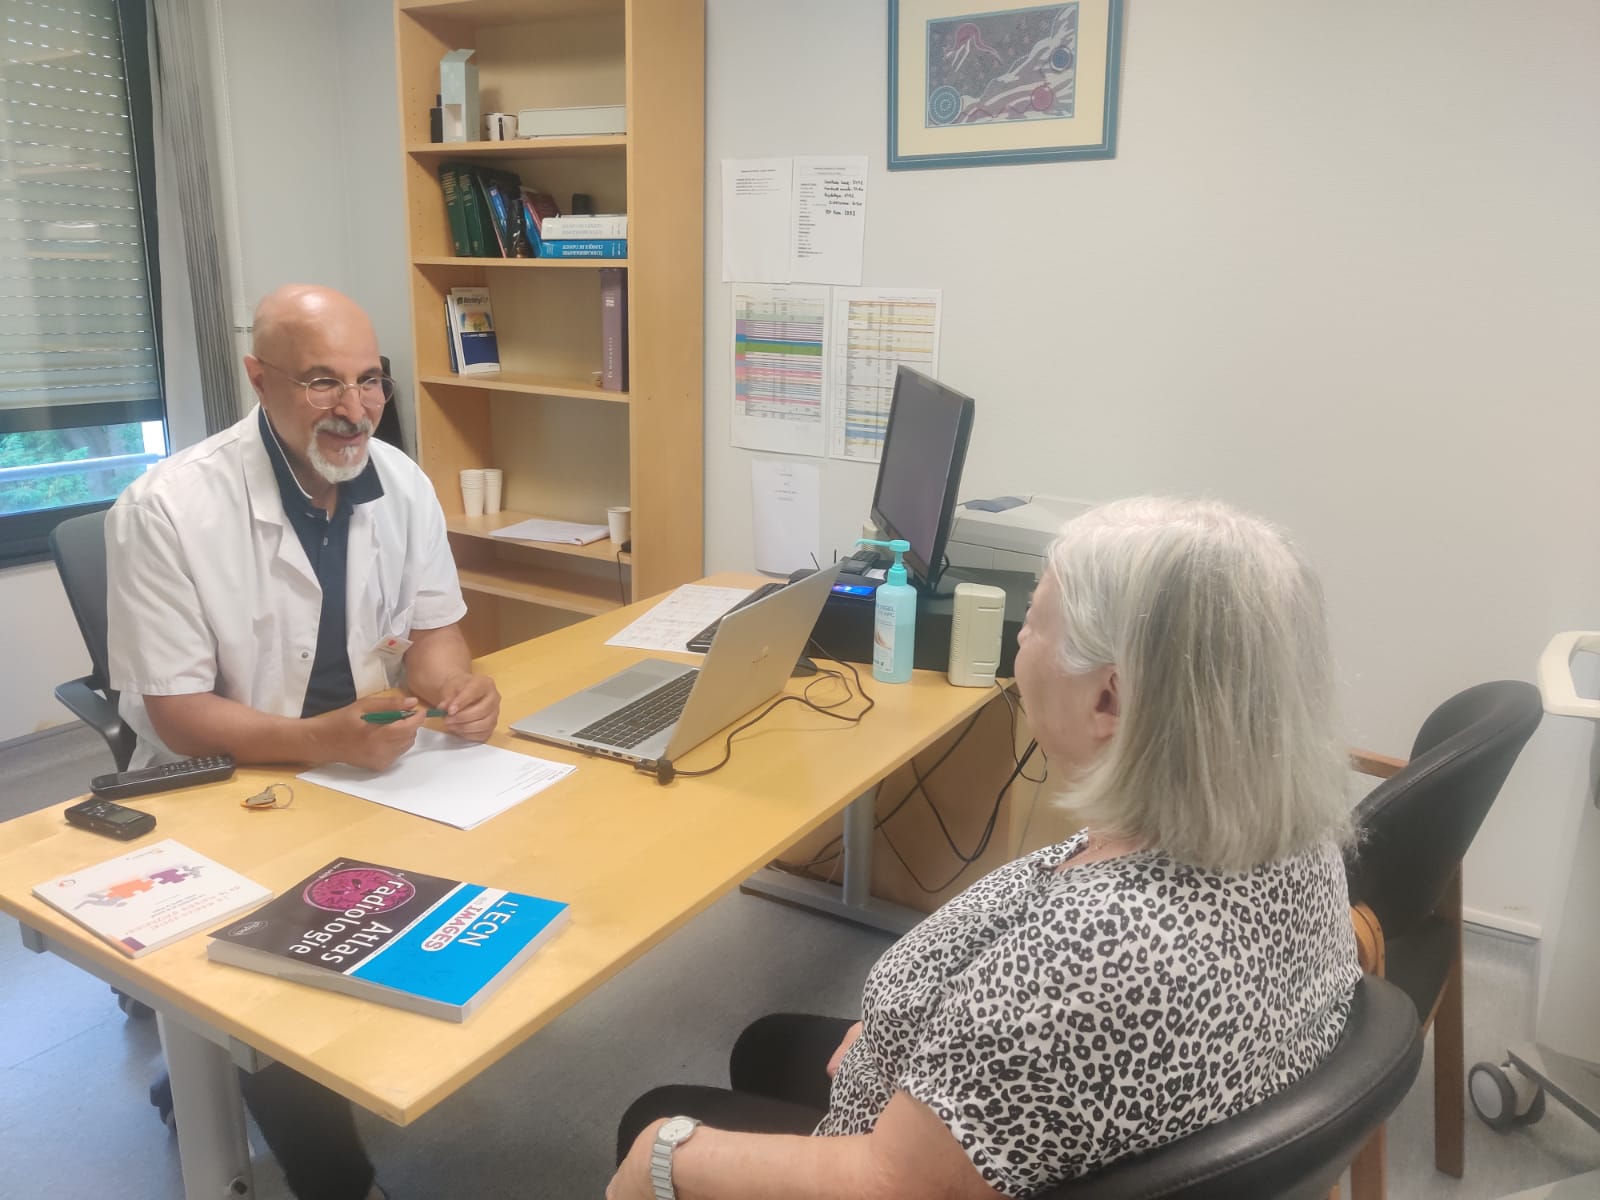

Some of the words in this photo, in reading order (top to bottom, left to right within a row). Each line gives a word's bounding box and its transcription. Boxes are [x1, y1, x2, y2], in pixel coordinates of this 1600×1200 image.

[289, 880, 405, 954] radiologie
[424, 904, 483, 950] IMAGES
[458, 900, 519, 946] L'ECN
[320, 921, 393, 963] Atlas
